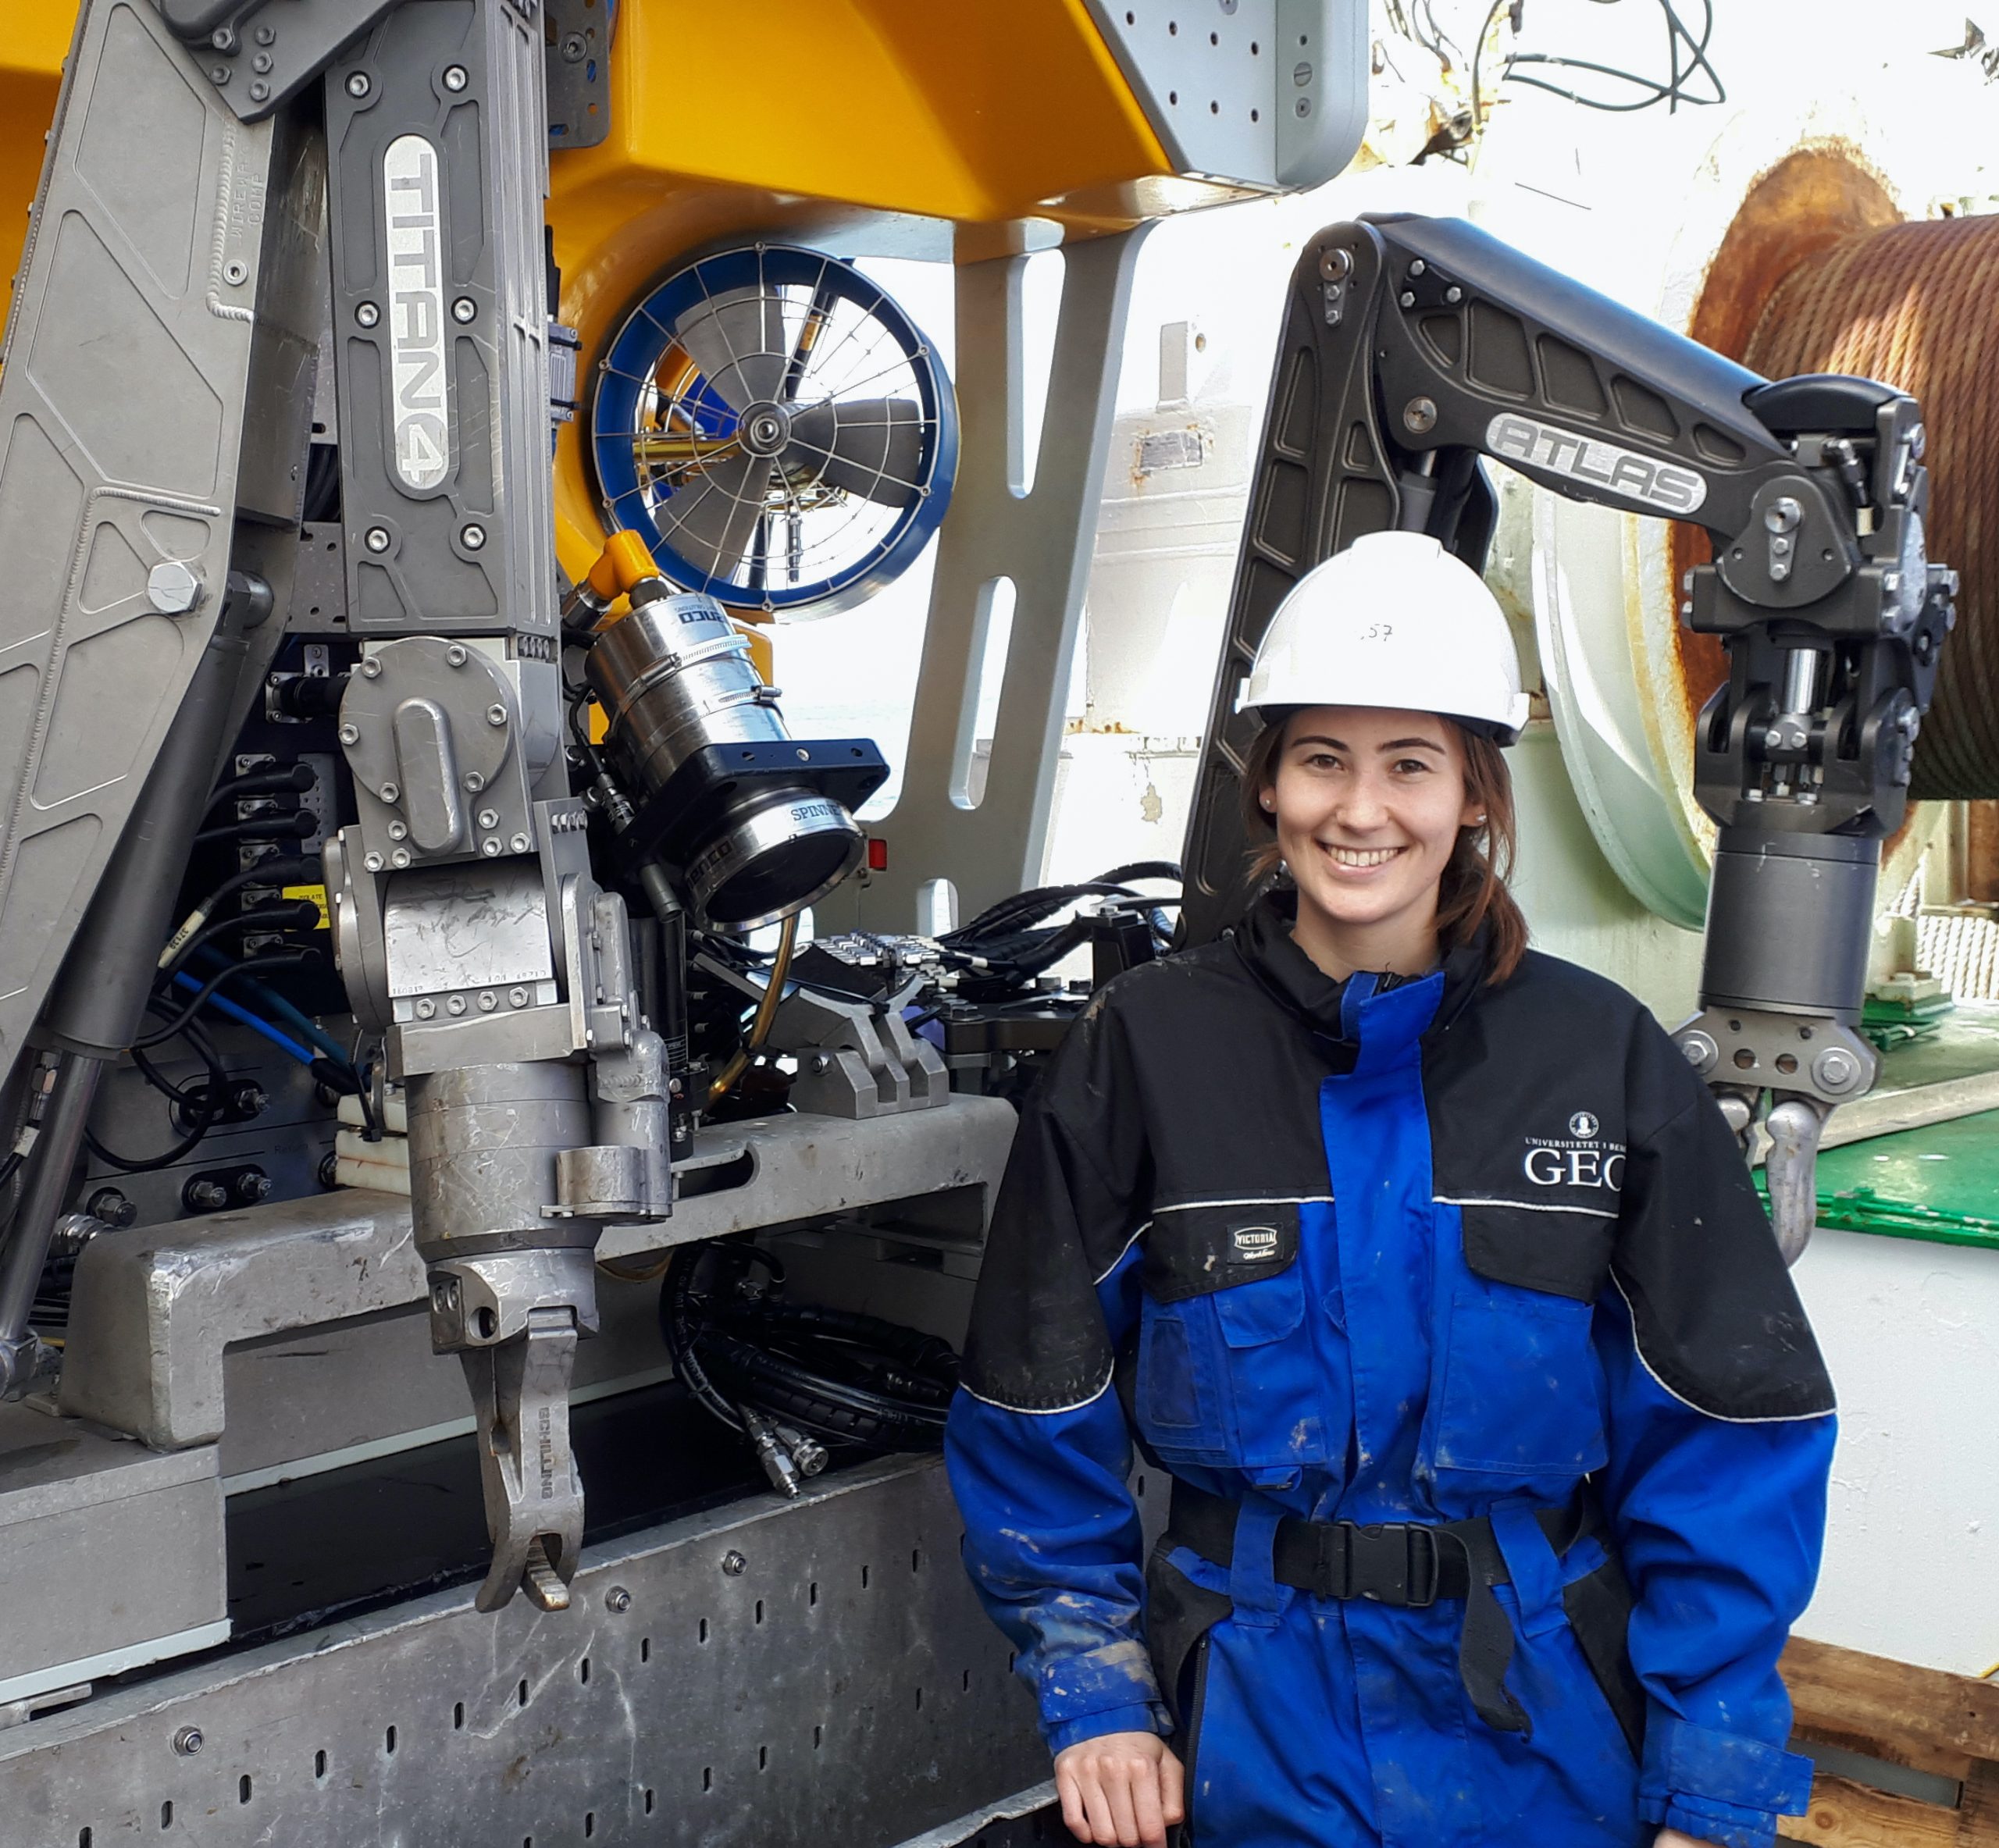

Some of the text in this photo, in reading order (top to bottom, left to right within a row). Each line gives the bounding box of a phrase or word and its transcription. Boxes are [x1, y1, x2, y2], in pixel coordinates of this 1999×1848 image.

[248, 173, 264, 225] COMP
[390, 153, 444, 482] TITAN 4
[1495, 418, 1699, 508] ATLAS
[790, 804, 841, 821] SPINNE
[1525, 1137, 1599, 1148] UNIVERSITETET
[1237, 1232, 1275, 1245] VICTORIA
[539, 1406, 553, 1500] SCHILLING
